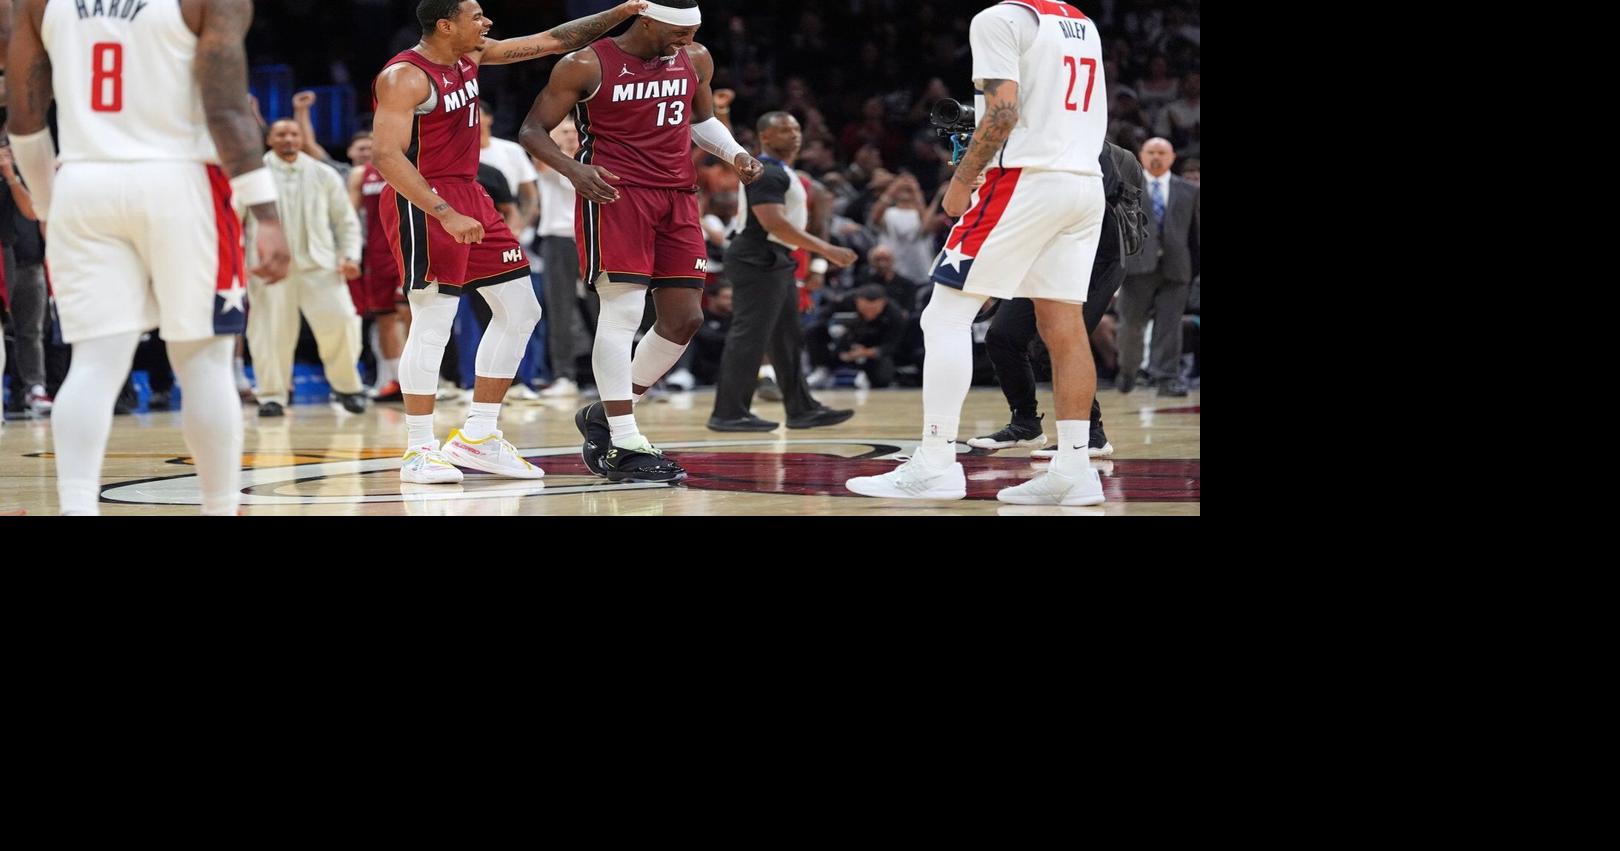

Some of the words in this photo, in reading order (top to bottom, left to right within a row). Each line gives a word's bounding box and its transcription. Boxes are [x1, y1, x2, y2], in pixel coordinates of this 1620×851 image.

[75, 0, 147, 22] HARDY
[1058, 20, 1086, 41] RILEY
[91, 42, 123, 113] 8
[612, 78, 688, 102] MIAMI
[1063, 55, 1097, 113] 27
[468, 102, 479, 127] 1
[656, 100, 685, 126] 13
